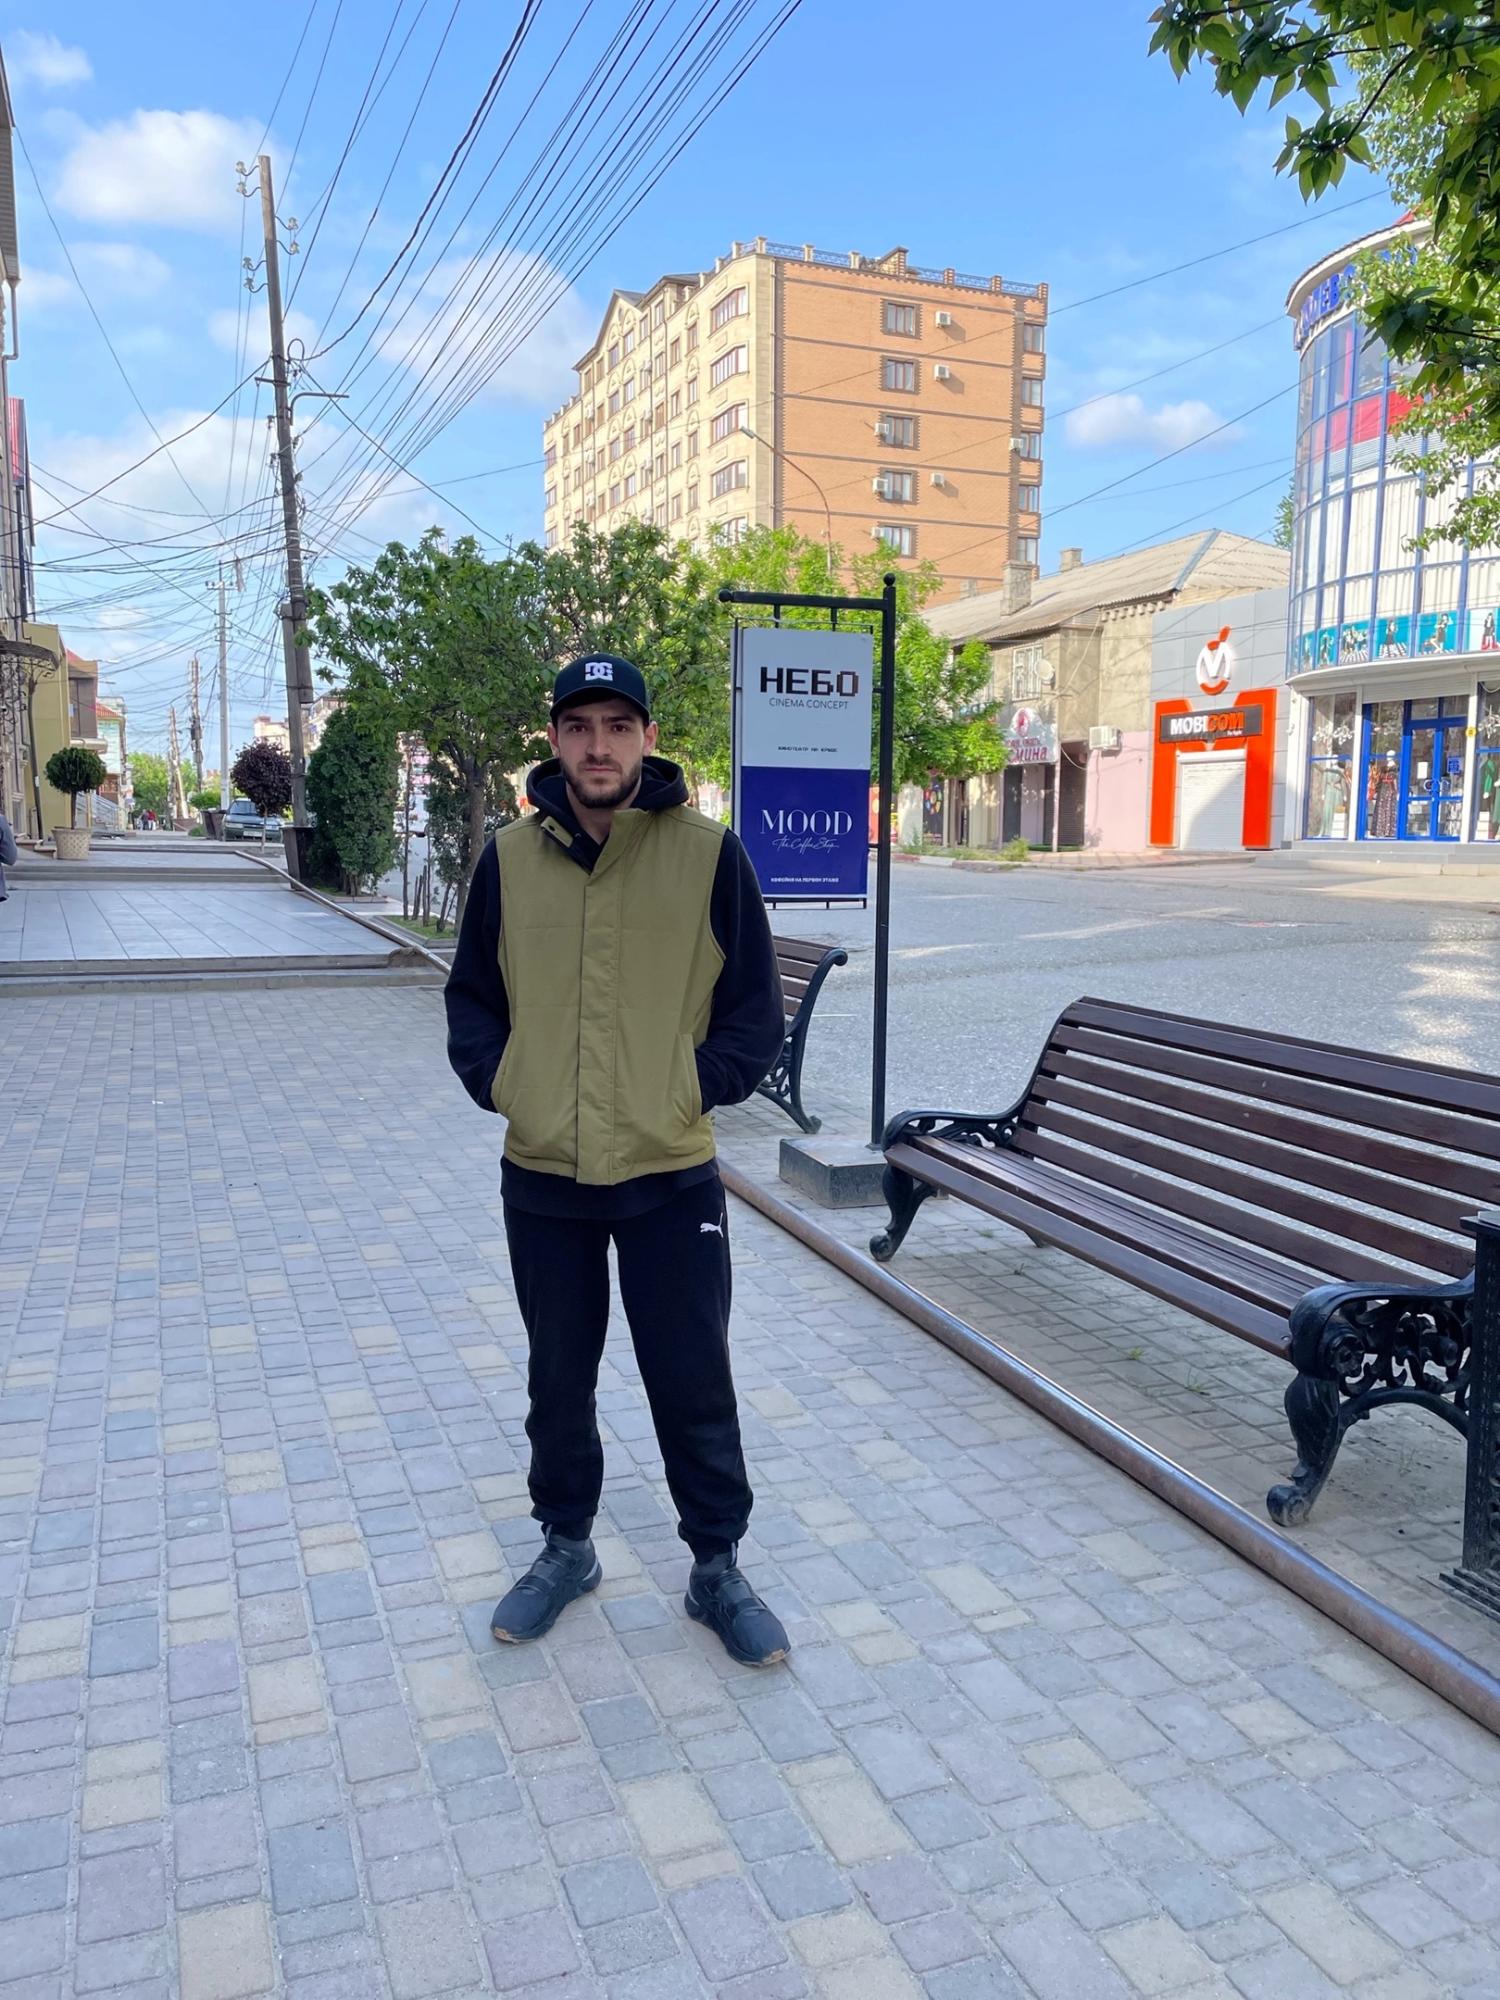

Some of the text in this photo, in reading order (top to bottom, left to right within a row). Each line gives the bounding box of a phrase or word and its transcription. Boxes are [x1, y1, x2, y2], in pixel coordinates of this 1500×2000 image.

[759, 666, 860, 698] НЕБО
[768, 697, 849, 710] CINEMA CONCEPT
[1169, 711, 1246, 736] MOBICOM
[759, 809, 853, 836] MOOD
[772, 834, 791, 852] The
